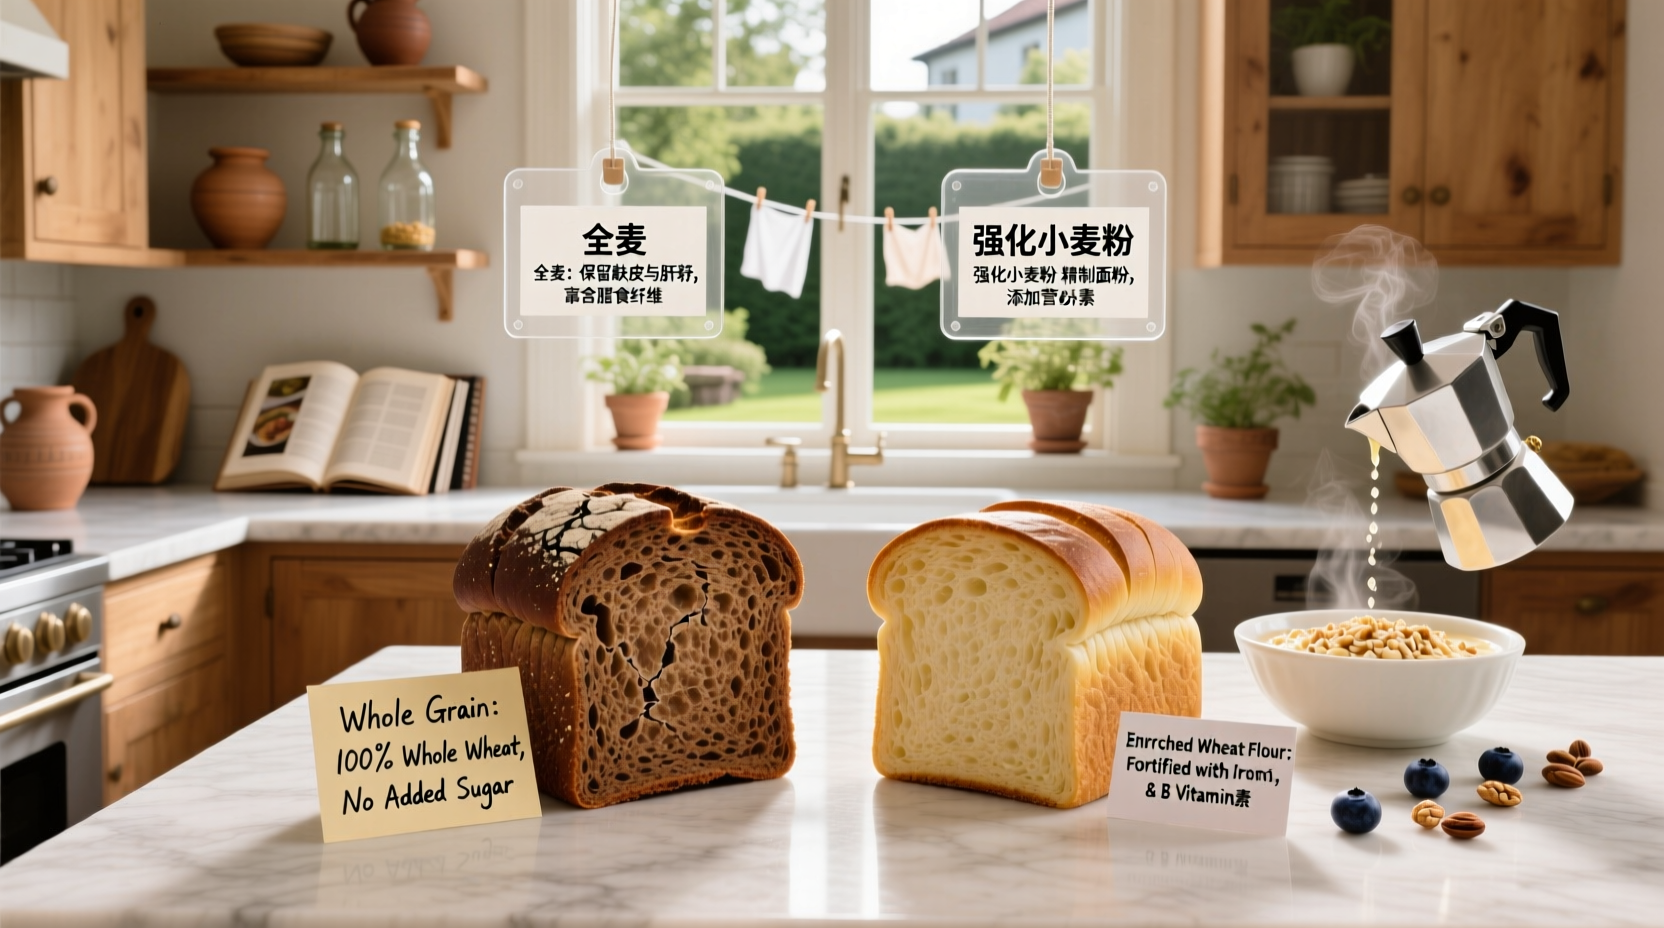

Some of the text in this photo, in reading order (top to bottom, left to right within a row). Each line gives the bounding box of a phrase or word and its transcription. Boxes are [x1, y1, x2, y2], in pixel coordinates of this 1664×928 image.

[582, 222, 647, 257] 全麦
[973, 223, 1134, 257] 强化小麦粉
[339, 694, 499, 733] Whole Grain:
[337, 734, 525, 775] 100% Whole Wheat,
[1197, 738, 1246, 757] Wheat
[1247, 742, 1293, 761] Flour:
[1126, 756, 1192, 776] Fortified
[1195, 761, 1229, 780] with
[342, 775, 514, 816] No Added Sugar
[1145, 781, 1157, 798] &
[1160, 783, 1171, 800] B
